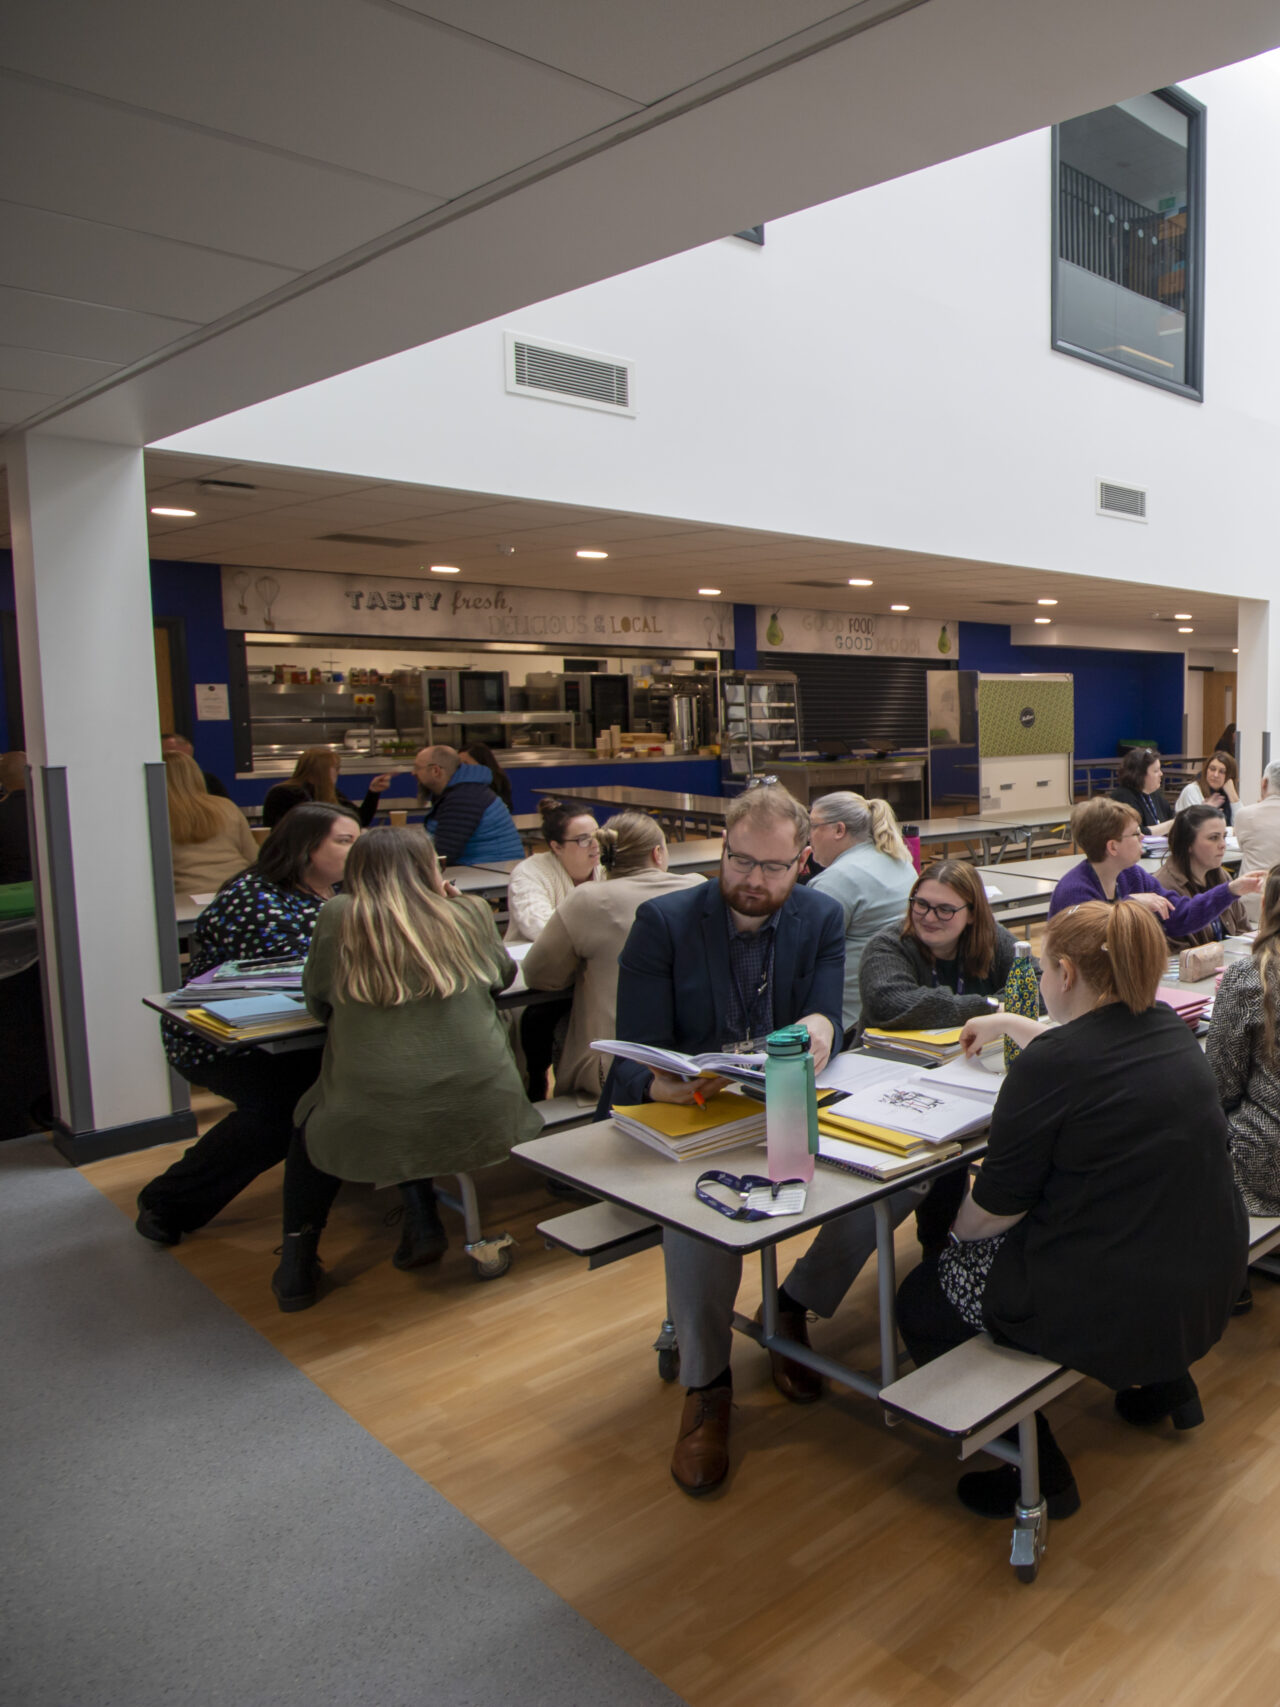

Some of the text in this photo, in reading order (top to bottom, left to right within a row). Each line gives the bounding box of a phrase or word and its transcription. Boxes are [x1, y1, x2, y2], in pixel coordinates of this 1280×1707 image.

[344, 590, 442, 611] TASTY
[488, 615, 587, 635] DELICIOUS
[610, 615, 663, 634] LOCAL
[802, 614, 844, 633] GOOD
[834, 635, 873, 651] GOOD
